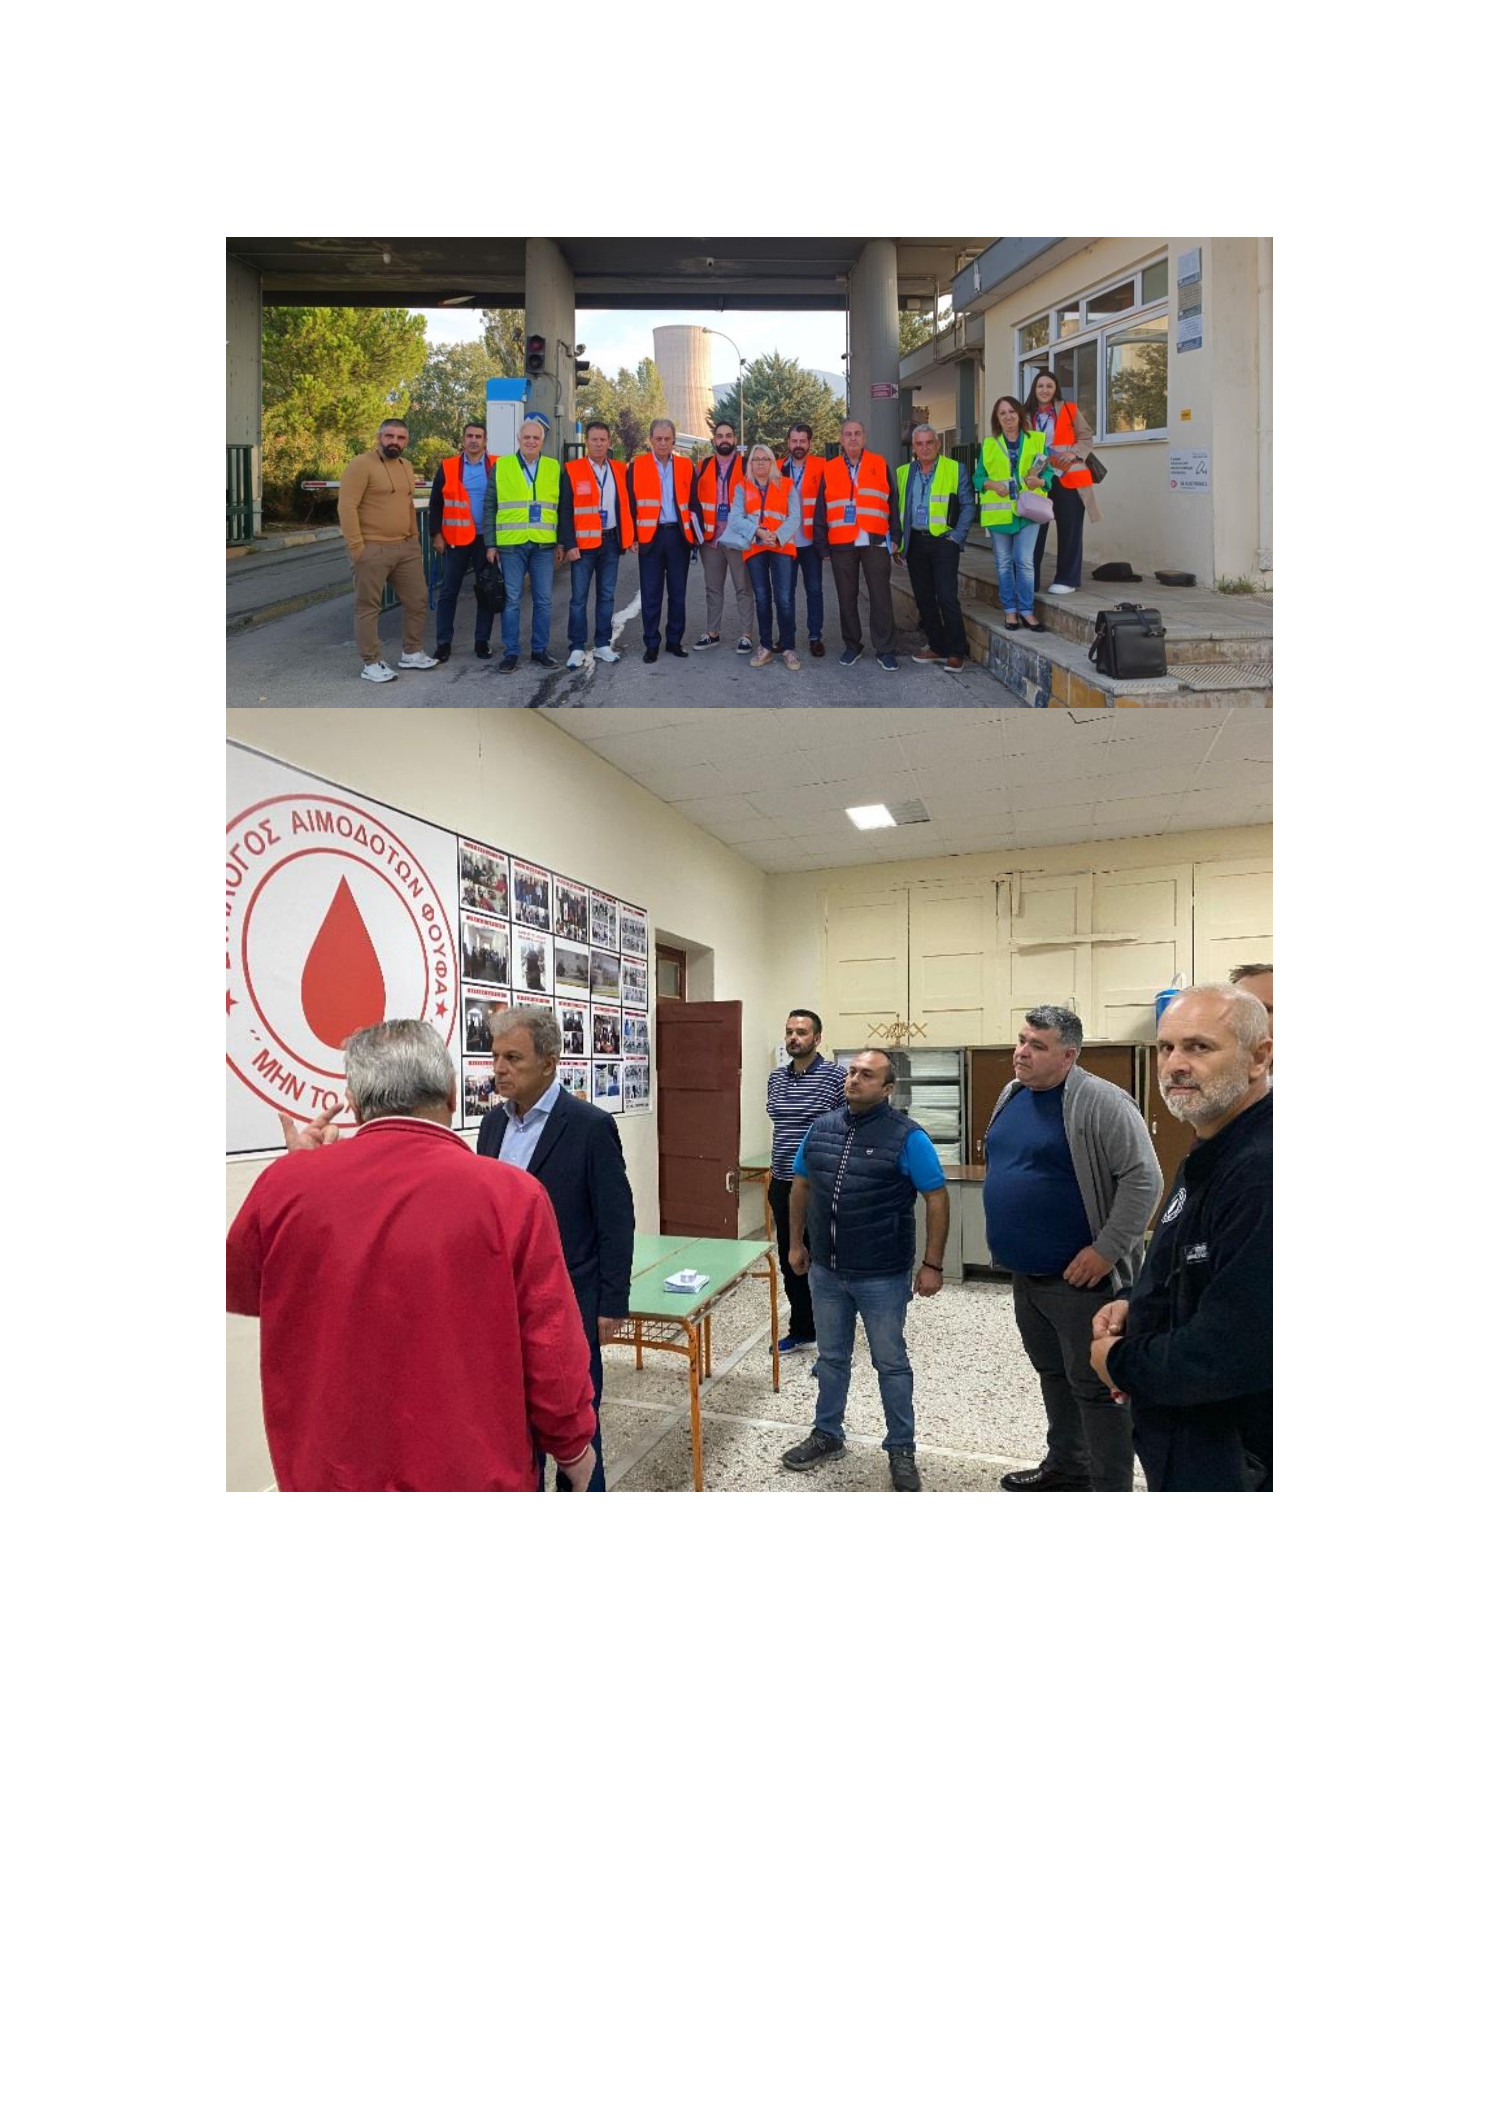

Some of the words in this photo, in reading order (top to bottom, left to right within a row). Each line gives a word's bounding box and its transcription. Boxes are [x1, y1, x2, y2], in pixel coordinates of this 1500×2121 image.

[291, 809, 424, 898] ΑΙΜΟΔΟΤΩΝ
[421, 903, 448, 996] ΦΟΥΦΑ
[251, 1048, 306, 1101] ΜΗΝ
